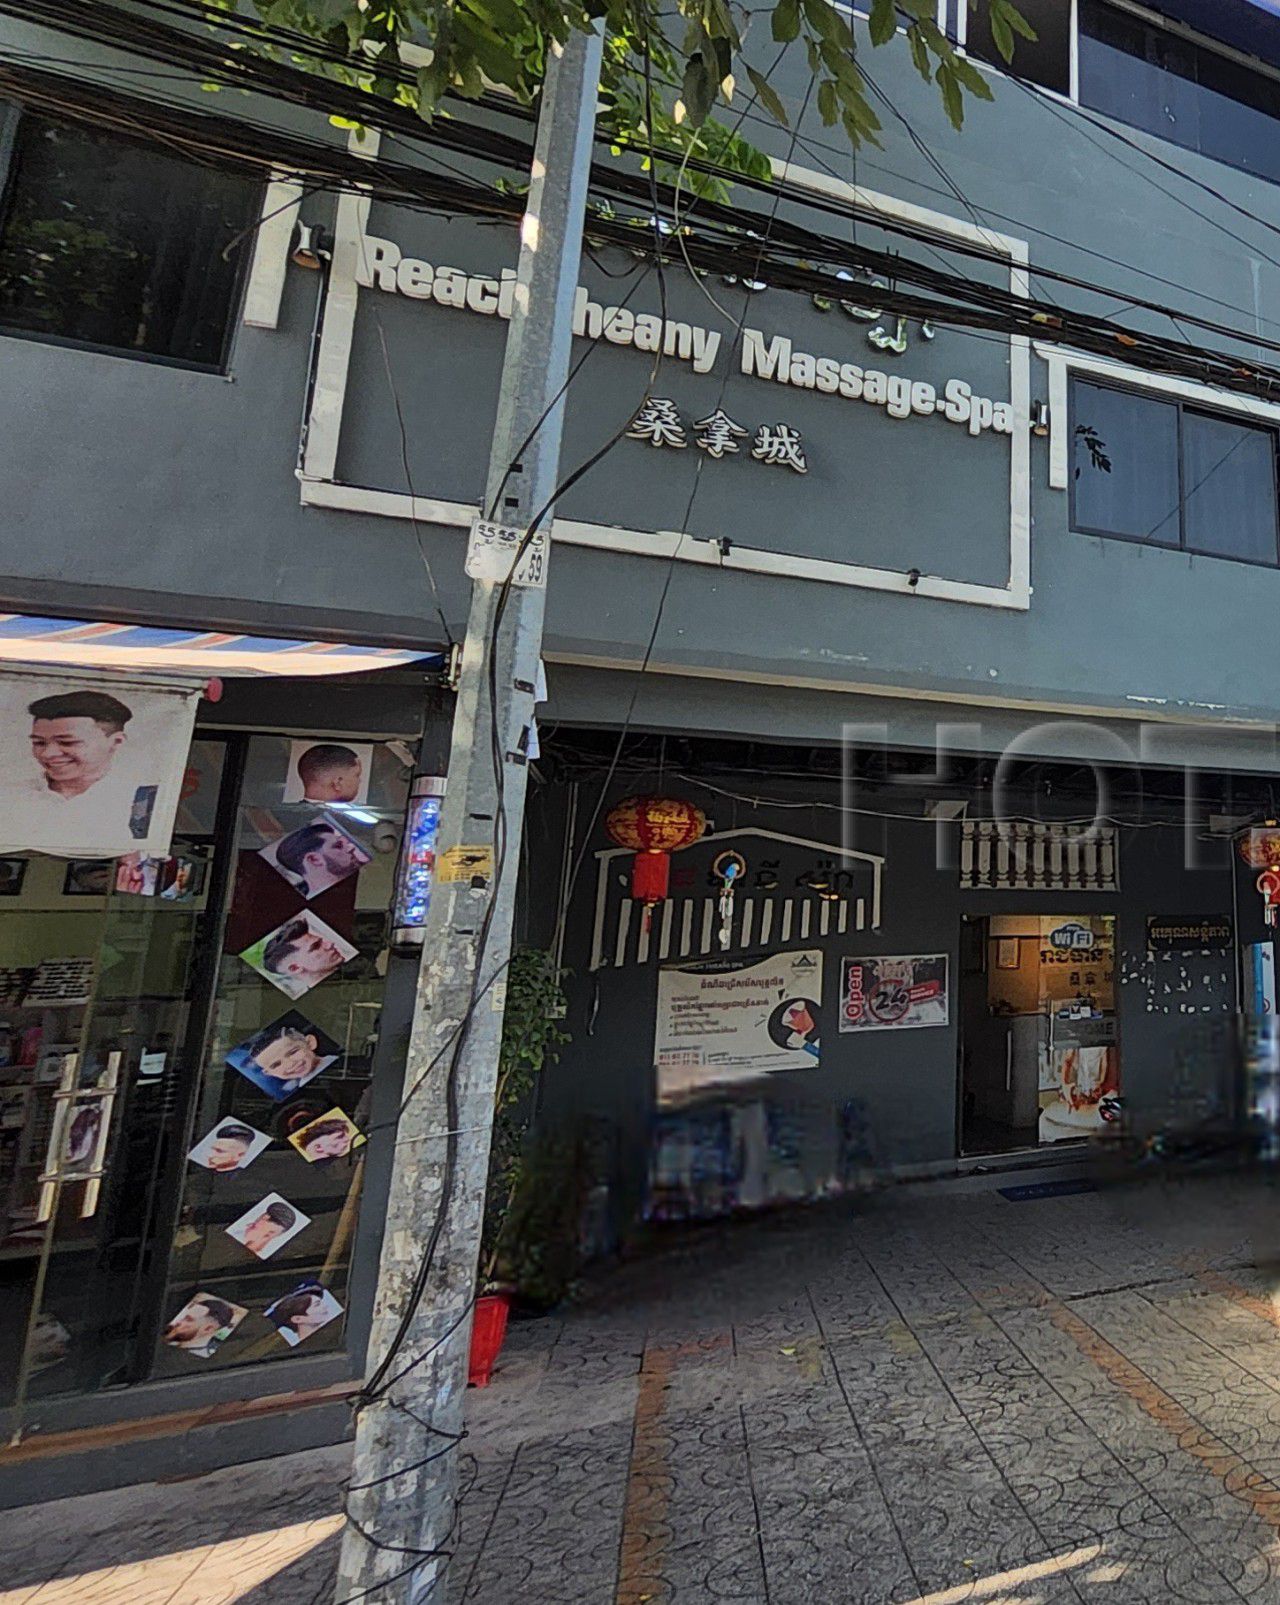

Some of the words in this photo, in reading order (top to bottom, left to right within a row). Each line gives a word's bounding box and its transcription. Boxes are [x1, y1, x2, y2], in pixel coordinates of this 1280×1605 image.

[572, 286, 721, 373] heany
[626, 397, 807, 474] 桑拿城
[846, 965, 866, 1019] Open
